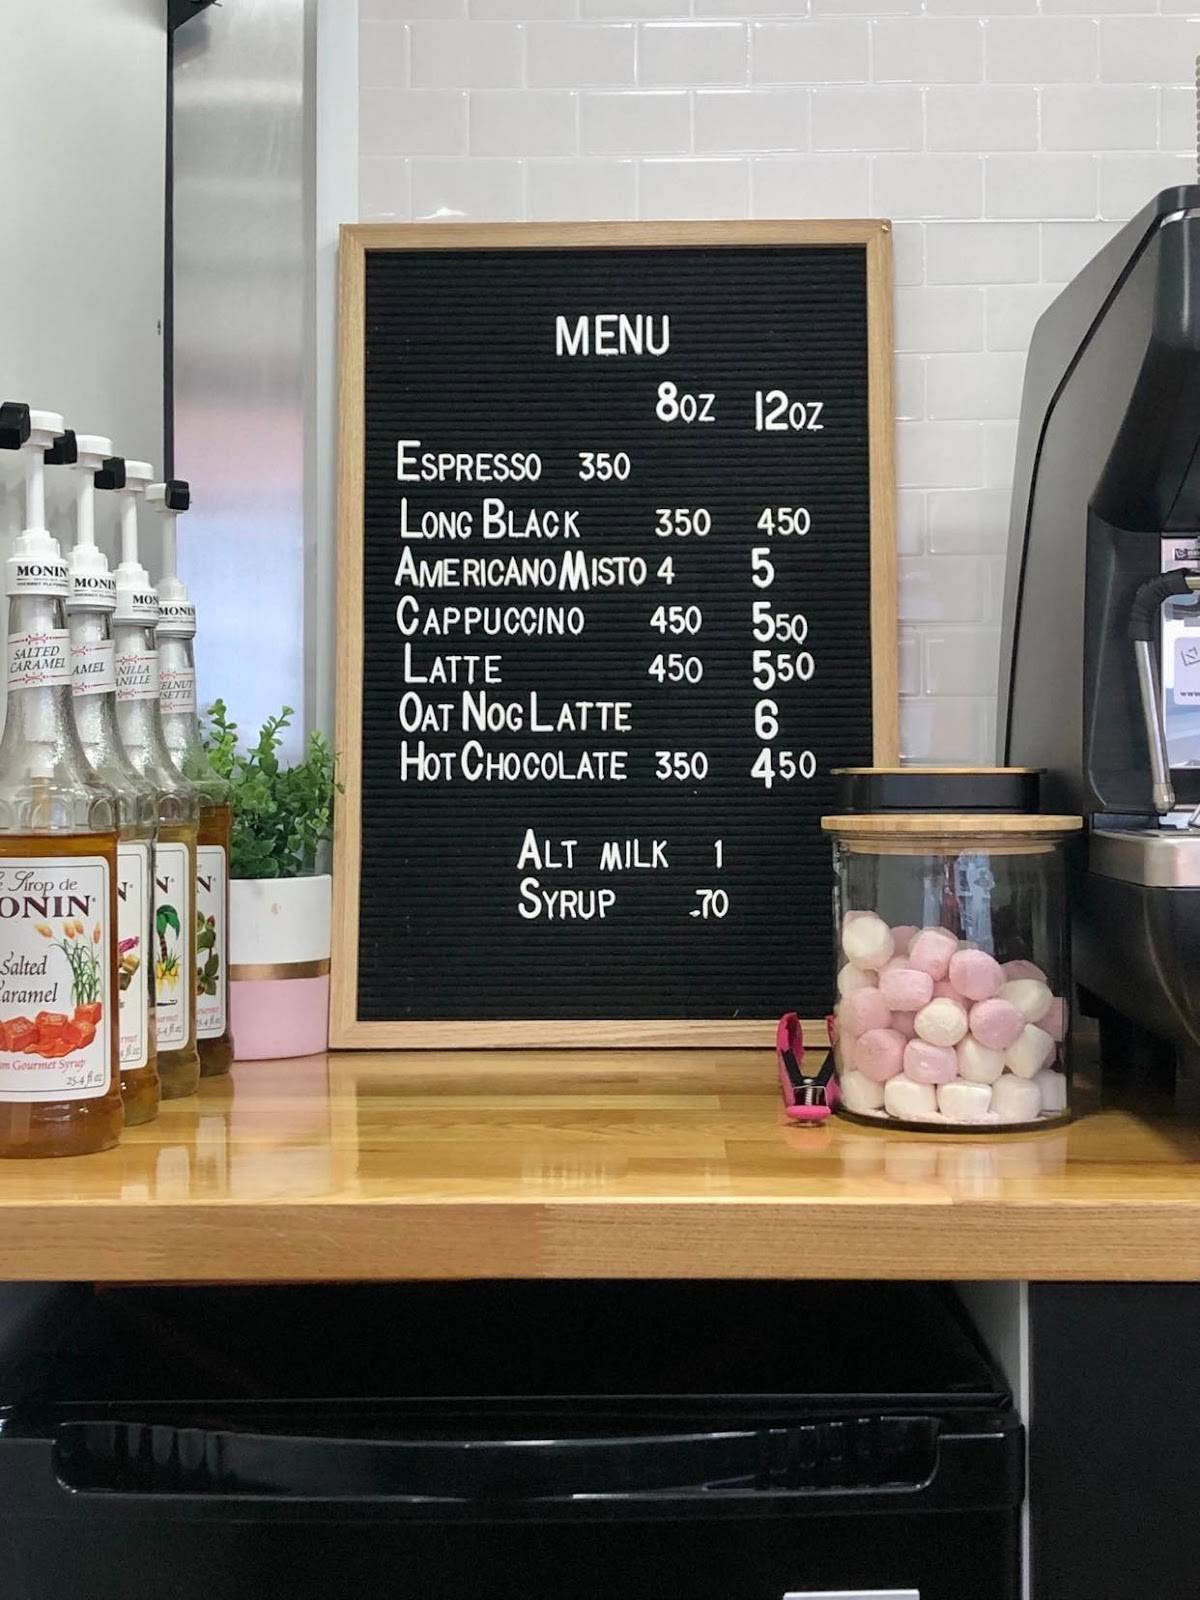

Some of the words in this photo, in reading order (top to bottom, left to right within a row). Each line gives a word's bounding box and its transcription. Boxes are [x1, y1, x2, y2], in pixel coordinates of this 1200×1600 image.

[555, 313, 670, 356] MENU
[397, 439, 542, 482] ESPRESSO
[578, 452, 631, 481] 350
[400, 497, 473, 540] LONG
[483, 497, 581, 540] BLACK
[654, 508, 712, 537] 350
[757, 507, 811, 537] 450
[17, 565, 69, 577] MONIN
[656, 556, 676, 586] 4
[751, 547, 775, 589] 5
[396, 595, 586, 636] CAPPUCCINO
[649, 605, 702, 635] 450
[752, 601, 808, 645] 550
[9, 658, 65, 673] CARAMEL
[14, 646, 60, 660] SALTED
[404, 642, 502, 684] LATTE
[648, 653, 703, 684] 450
[752, 649, 815, 691] 550
[399, 691, 455, 733] OAT
[462, 690, 524, 733] NOG
[530, 690, 633, 734] LATTE
[754, 698, 779, 740] 6
[400, 740, 457, 783] HOT
[460, 739, 629, 782] CHOCOLATE
[655, 751, 709, 781] 350
[750, 747, 817, 790] 450
[516, 828, 578, 870] ALT
[599, 839, 669, 873] MILK
[714, 839, 723, 869] 1
[8, 870, 54, 896] Sirop
[59, 878, 78, 891] de
[518, 876, 616, 920] SYRUP
[0, 951, 47, 975] Salted
